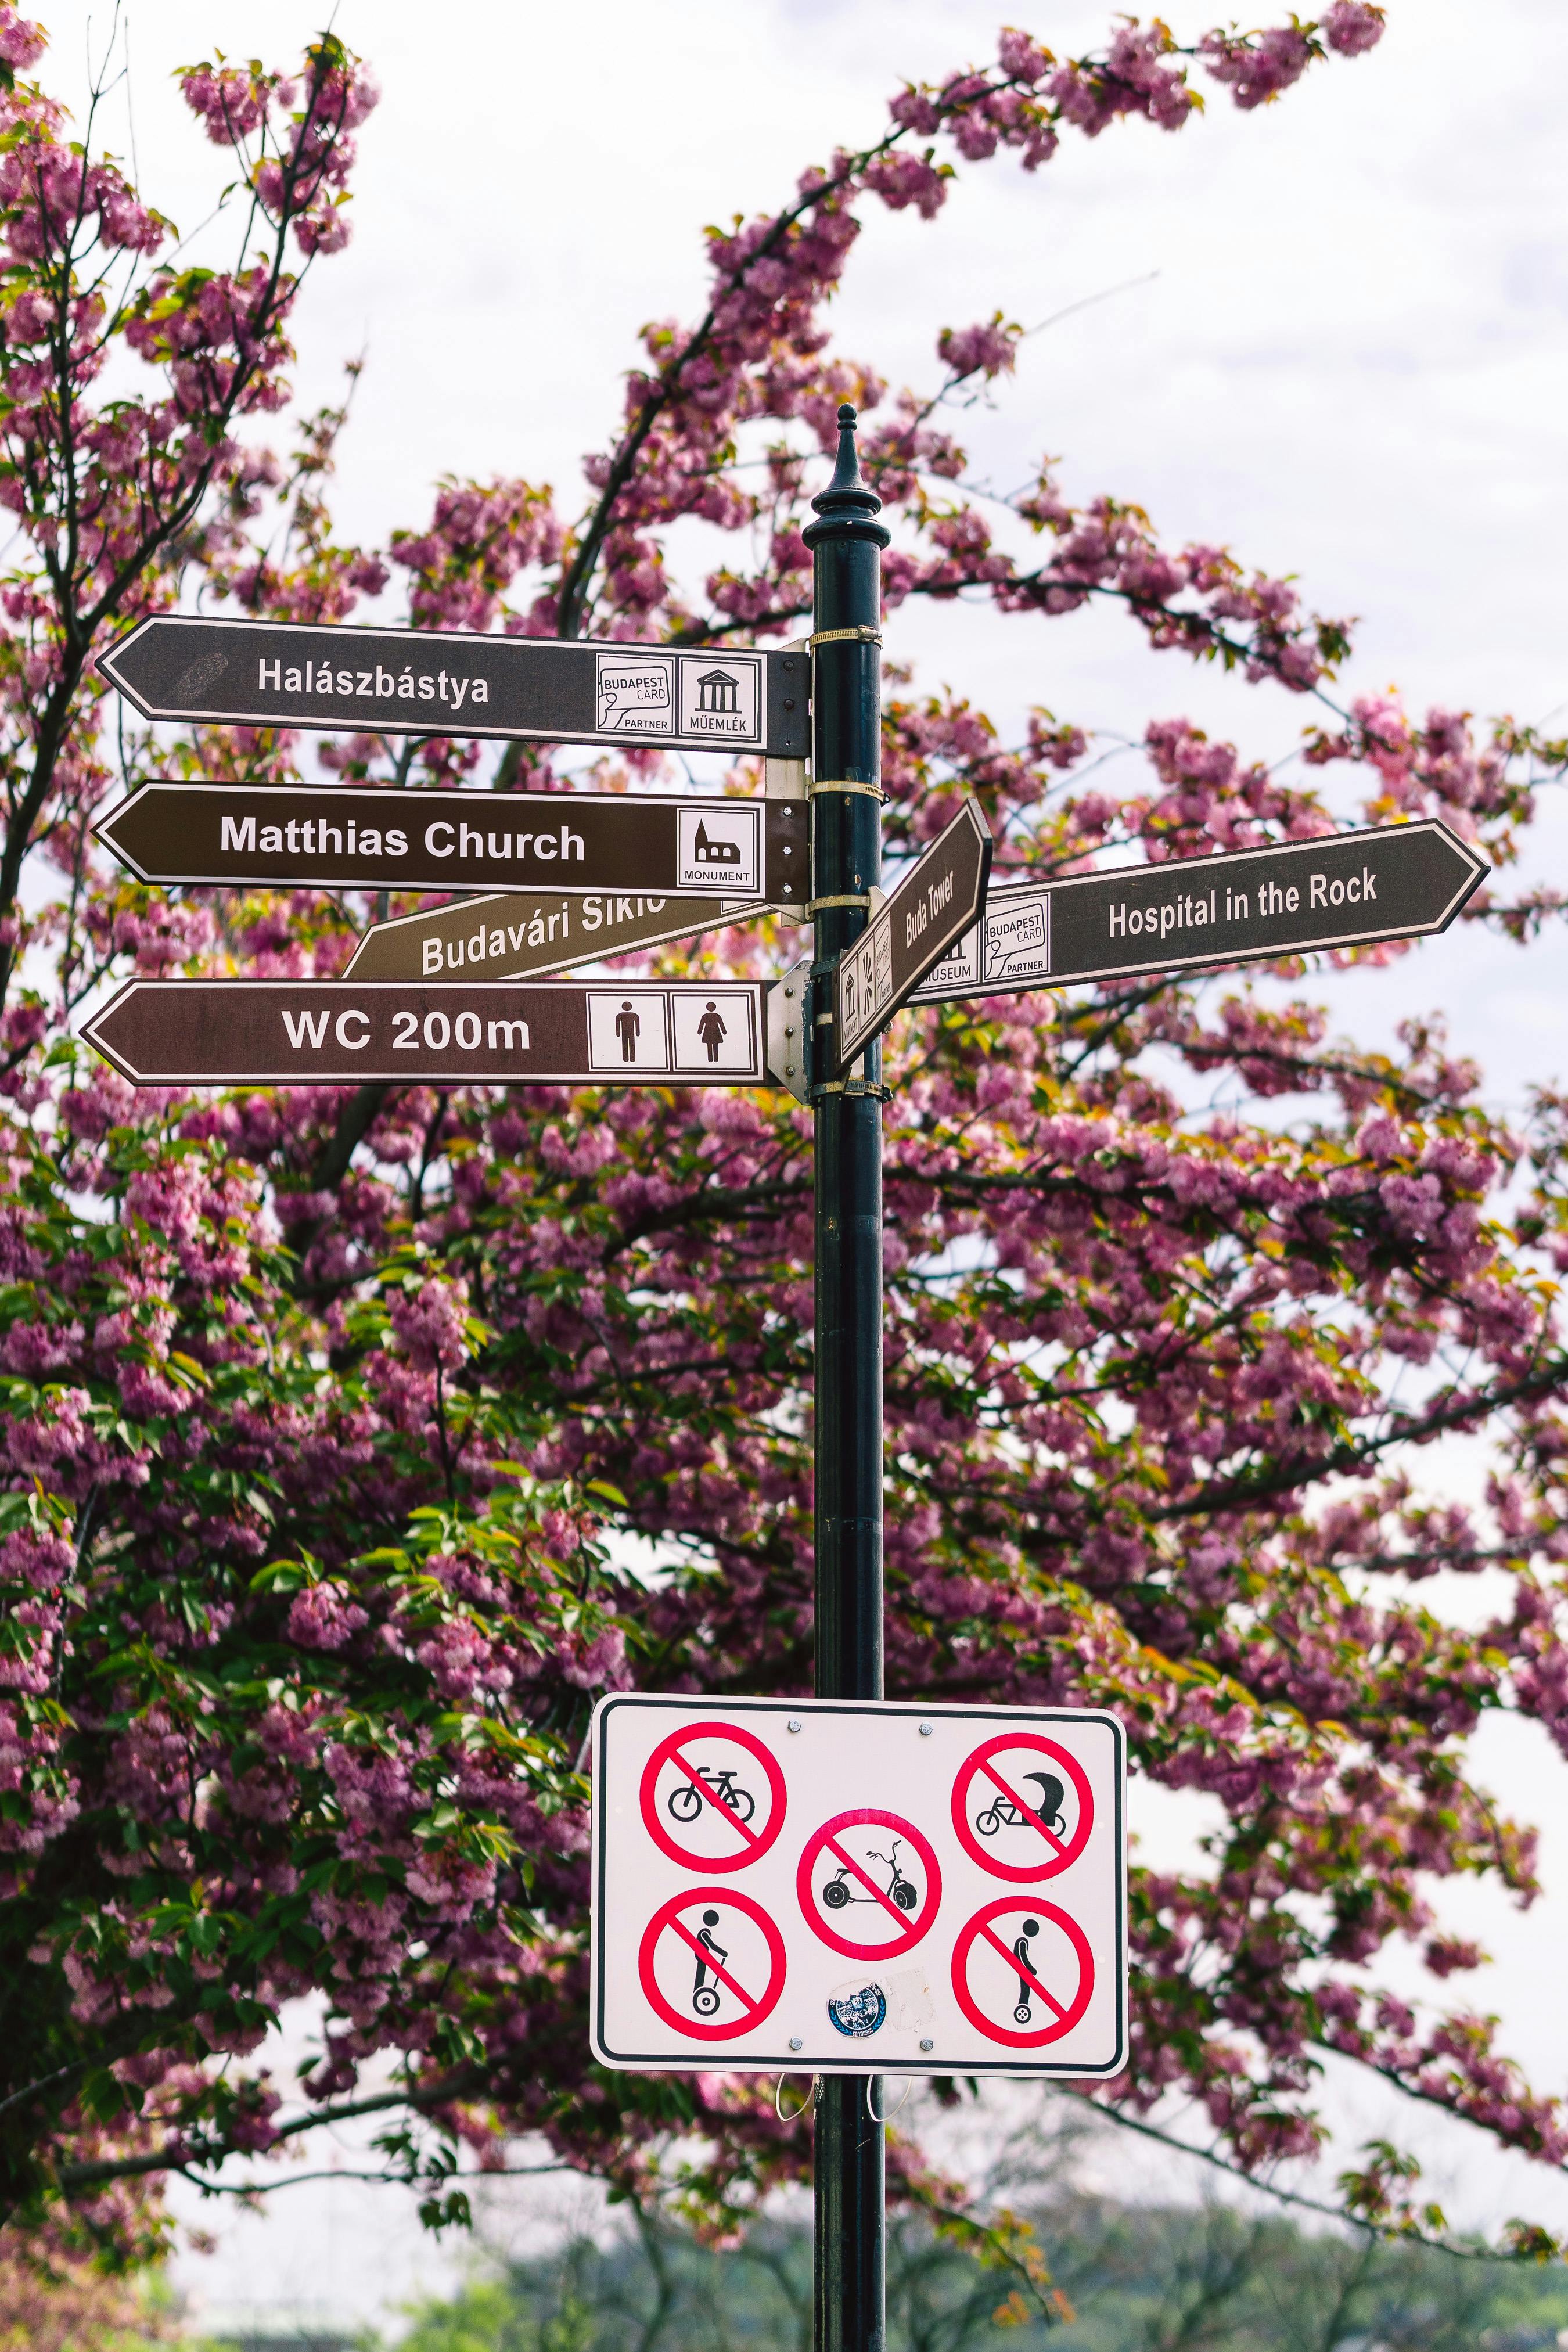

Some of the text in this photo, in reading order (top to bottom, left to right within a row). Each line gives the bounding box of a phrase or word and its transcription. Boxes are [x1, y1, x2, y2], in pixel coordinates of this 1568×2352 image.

[258, 658, 488, 710] Halászbástya
[605, 677, 664, 690] BUDAPEST
[637, 689, 666, 700] CARD
[625, 719, 667, 729] PARTNER
[690, 715, 747, 732] MŰEMLÉK
[221, 816, 585, 861] Matthias Church
[685, 871, 750, 882] MONUMENT
[906, 871, 954, 949] Buda Tower
[1109, 867, 1378, 939] Hospital in the Rock
[990, 915, 1040, 938] BUDAPEST
[1017, 927, 1041, 943] CARD
[422, 901, 570, 977] Budavári
[1007, 961, 1044, 973] PARTNER
[281, 1010, 531, 1051] WC 200m
